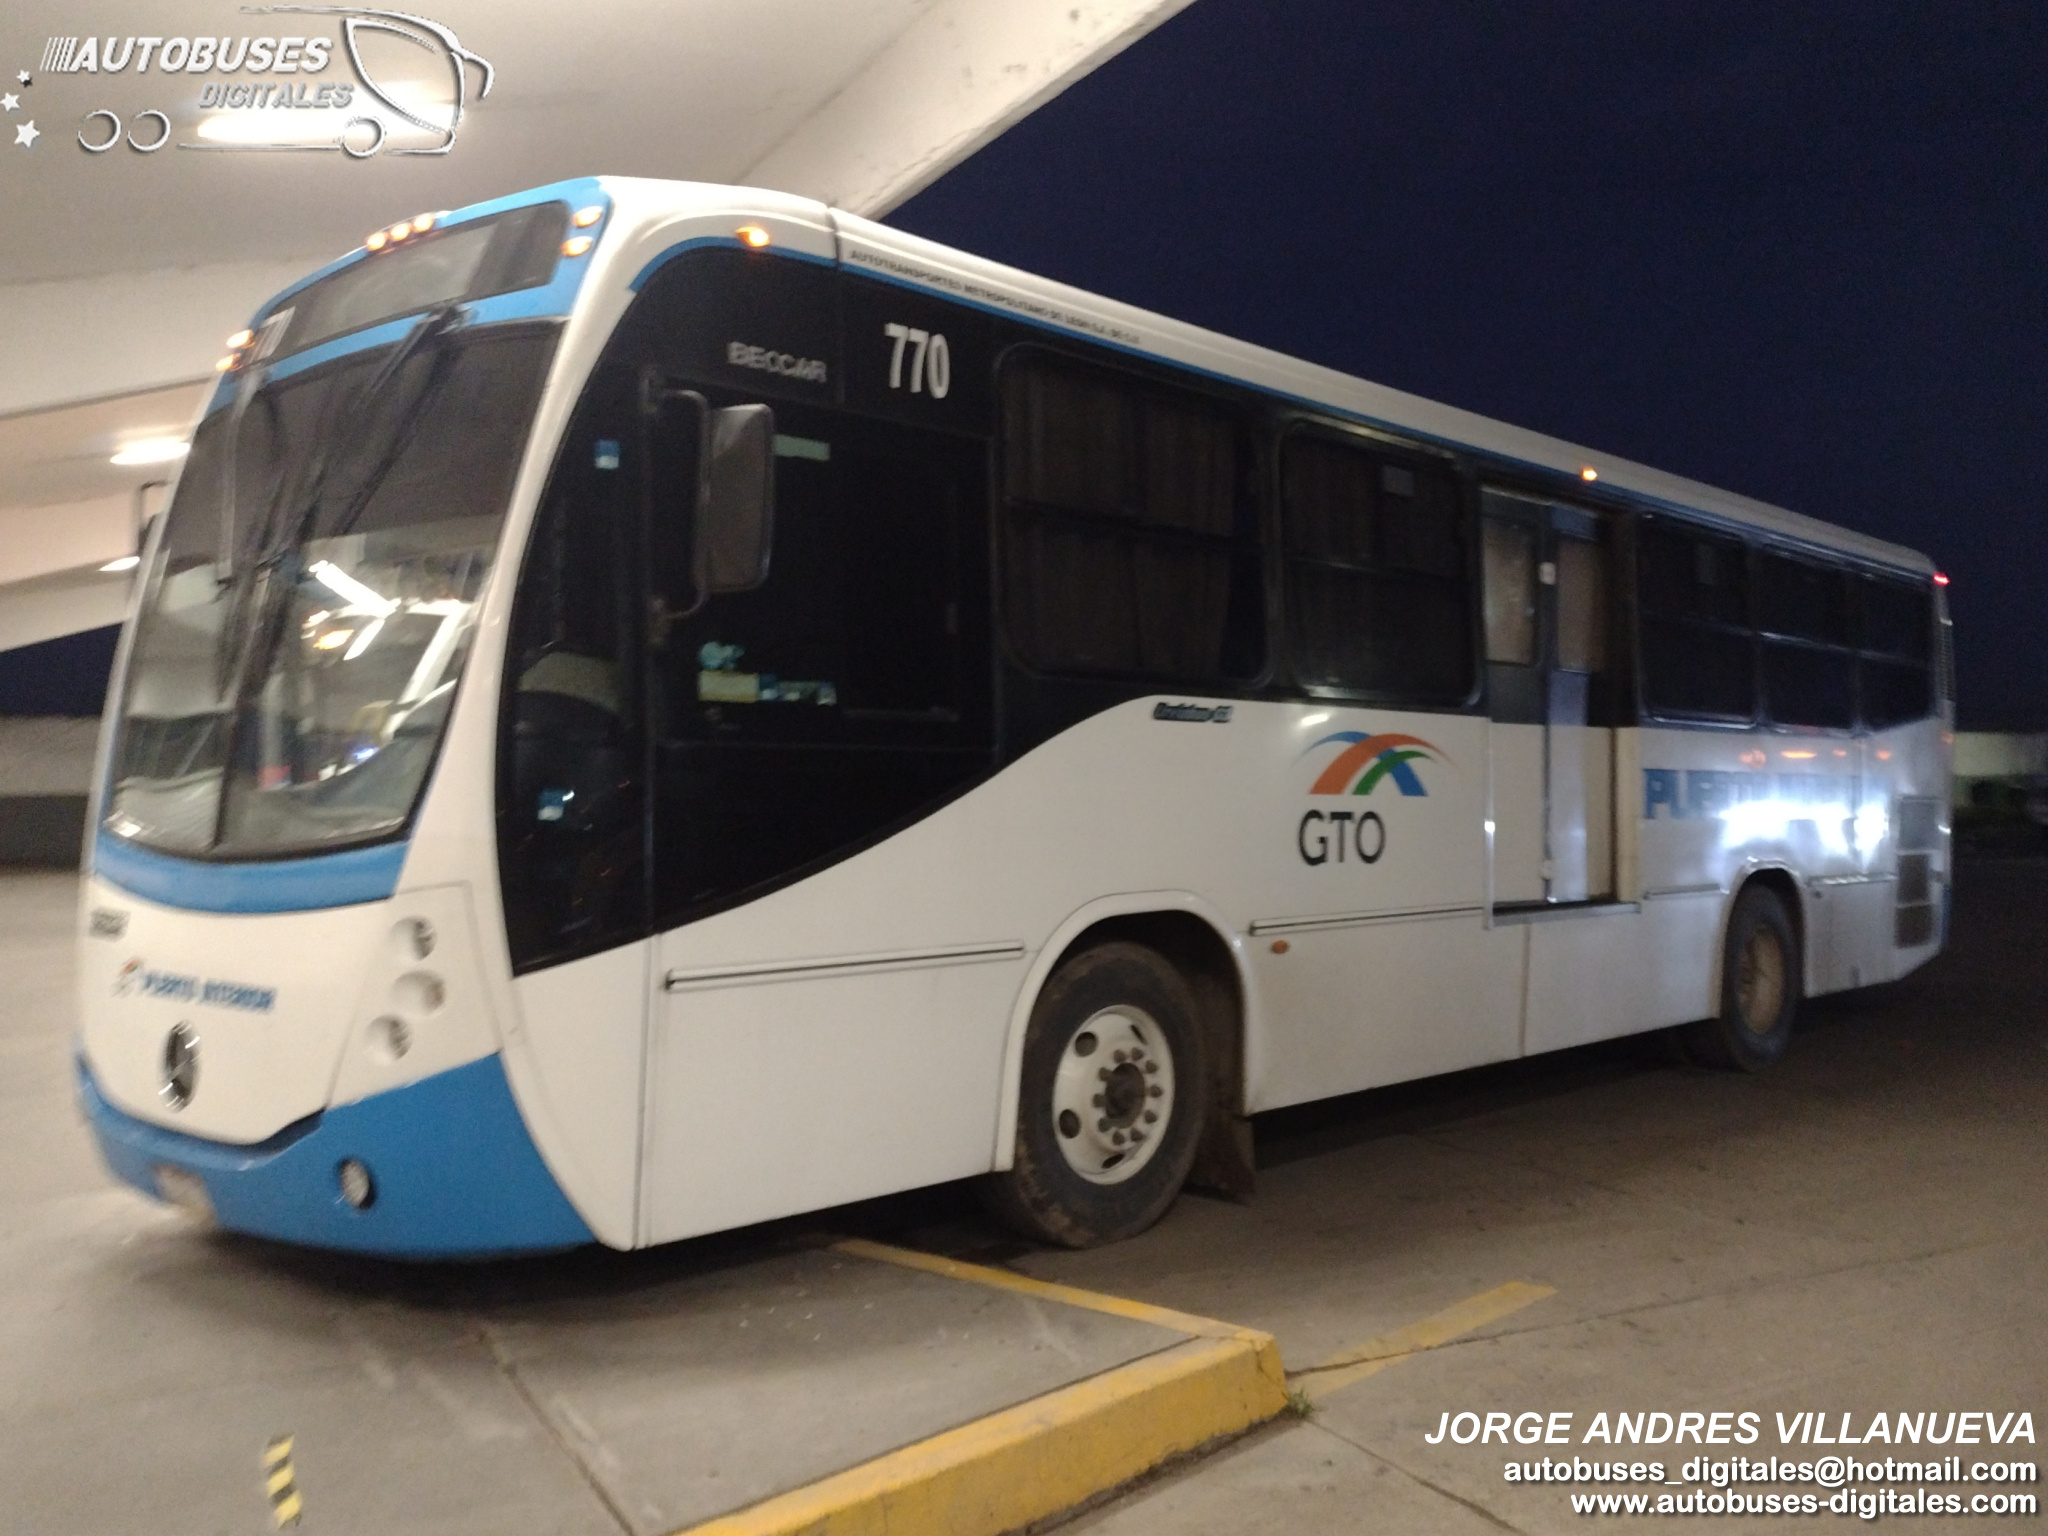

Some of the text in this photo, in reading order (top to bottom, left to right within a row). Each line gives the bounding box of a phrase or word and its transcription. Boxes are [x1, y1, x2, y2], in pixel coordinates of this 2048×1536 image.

[727, 341, 827, 383] BECCAR
[886, 322, 950, 399] 770
[1298, 808, 1387, 867] GTO
